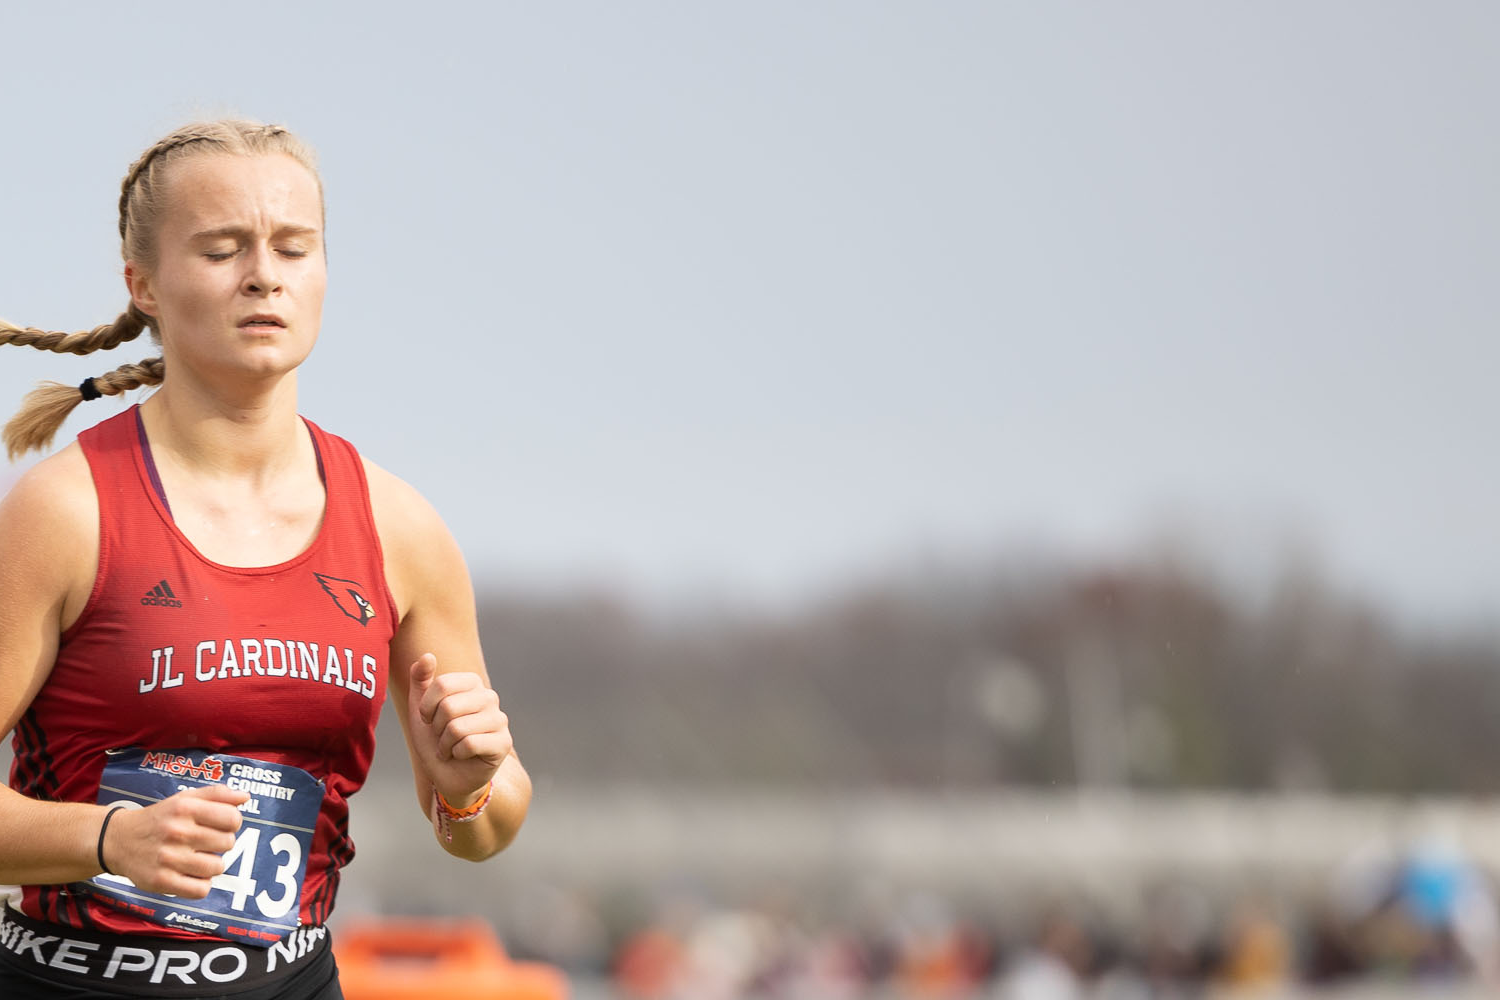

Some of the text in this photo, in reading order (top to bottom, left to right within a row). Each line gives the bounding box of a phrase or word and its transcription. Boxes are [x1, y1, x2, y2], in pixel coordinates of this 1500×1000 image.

[140, 596, 182, 608] adidas
[139, 638, 377, 700] JL CARDINALS
[230, 763, 282, 784] CROSS
[226, 777, 296, 801] COUNTRY
[103, 946, 247, 985] PRO
